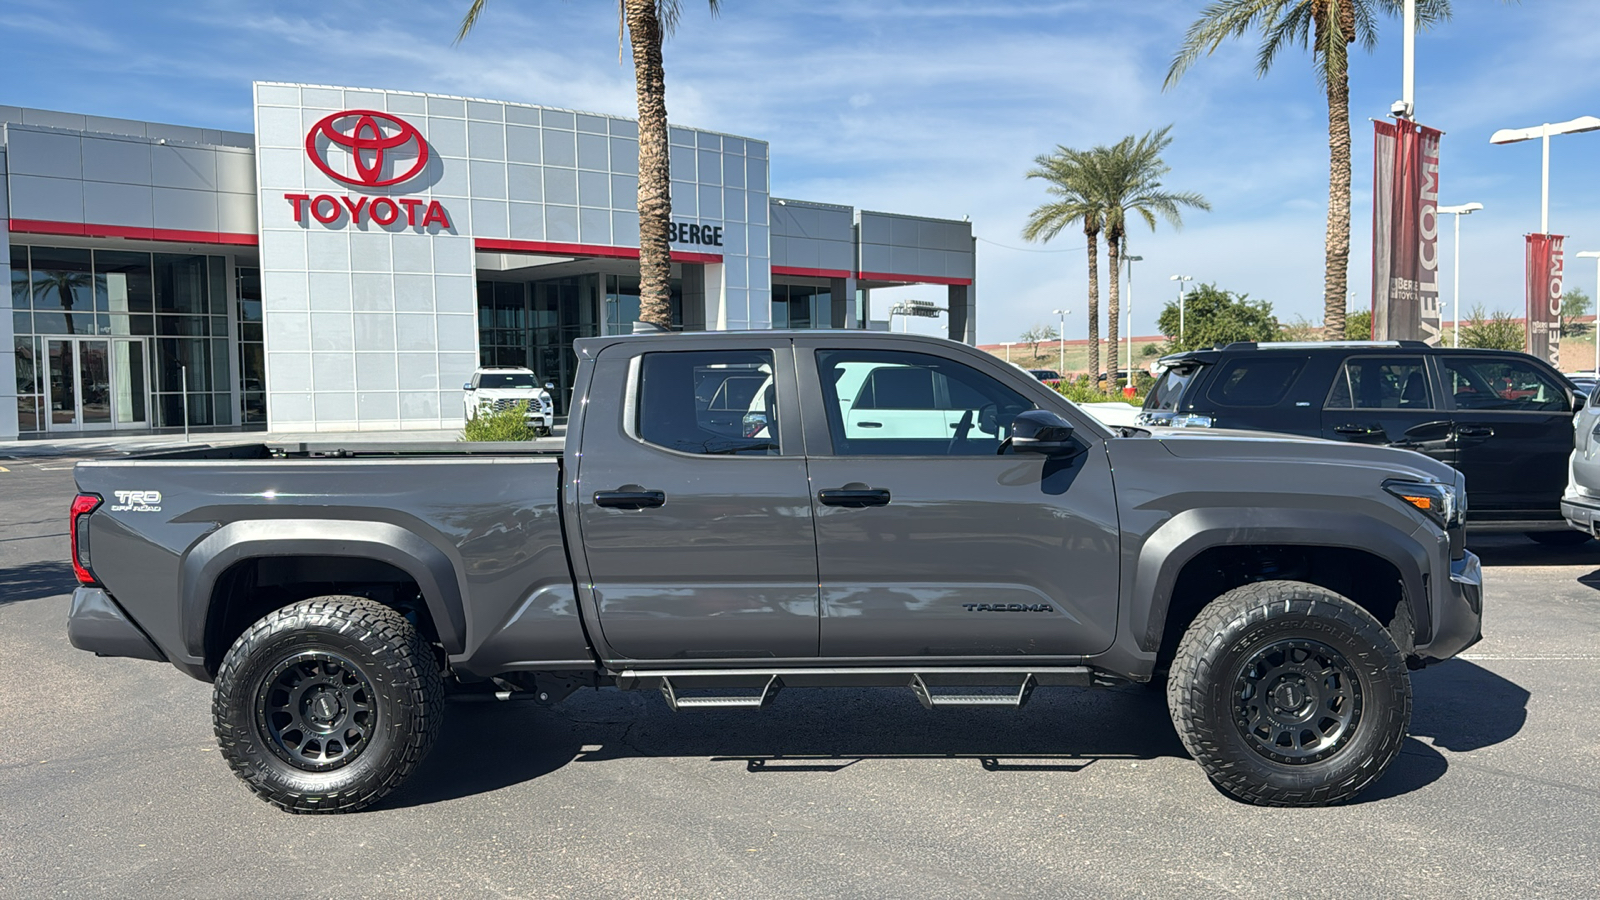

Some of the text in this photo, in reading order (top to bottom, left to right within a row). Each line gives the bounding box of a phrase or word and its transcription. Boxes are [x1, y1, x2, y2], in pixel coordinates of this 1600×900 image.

[284, 193, 450, 228] TOYOTA
[668, 222, 723, 246] BERGE
[1548, 238, 1564, 370] WELCOME
[114, 490, 161, 505] TRD
[111, 504, 161, 512] OFF ROAD
[962, 603, 1053, 612] TACOMA
